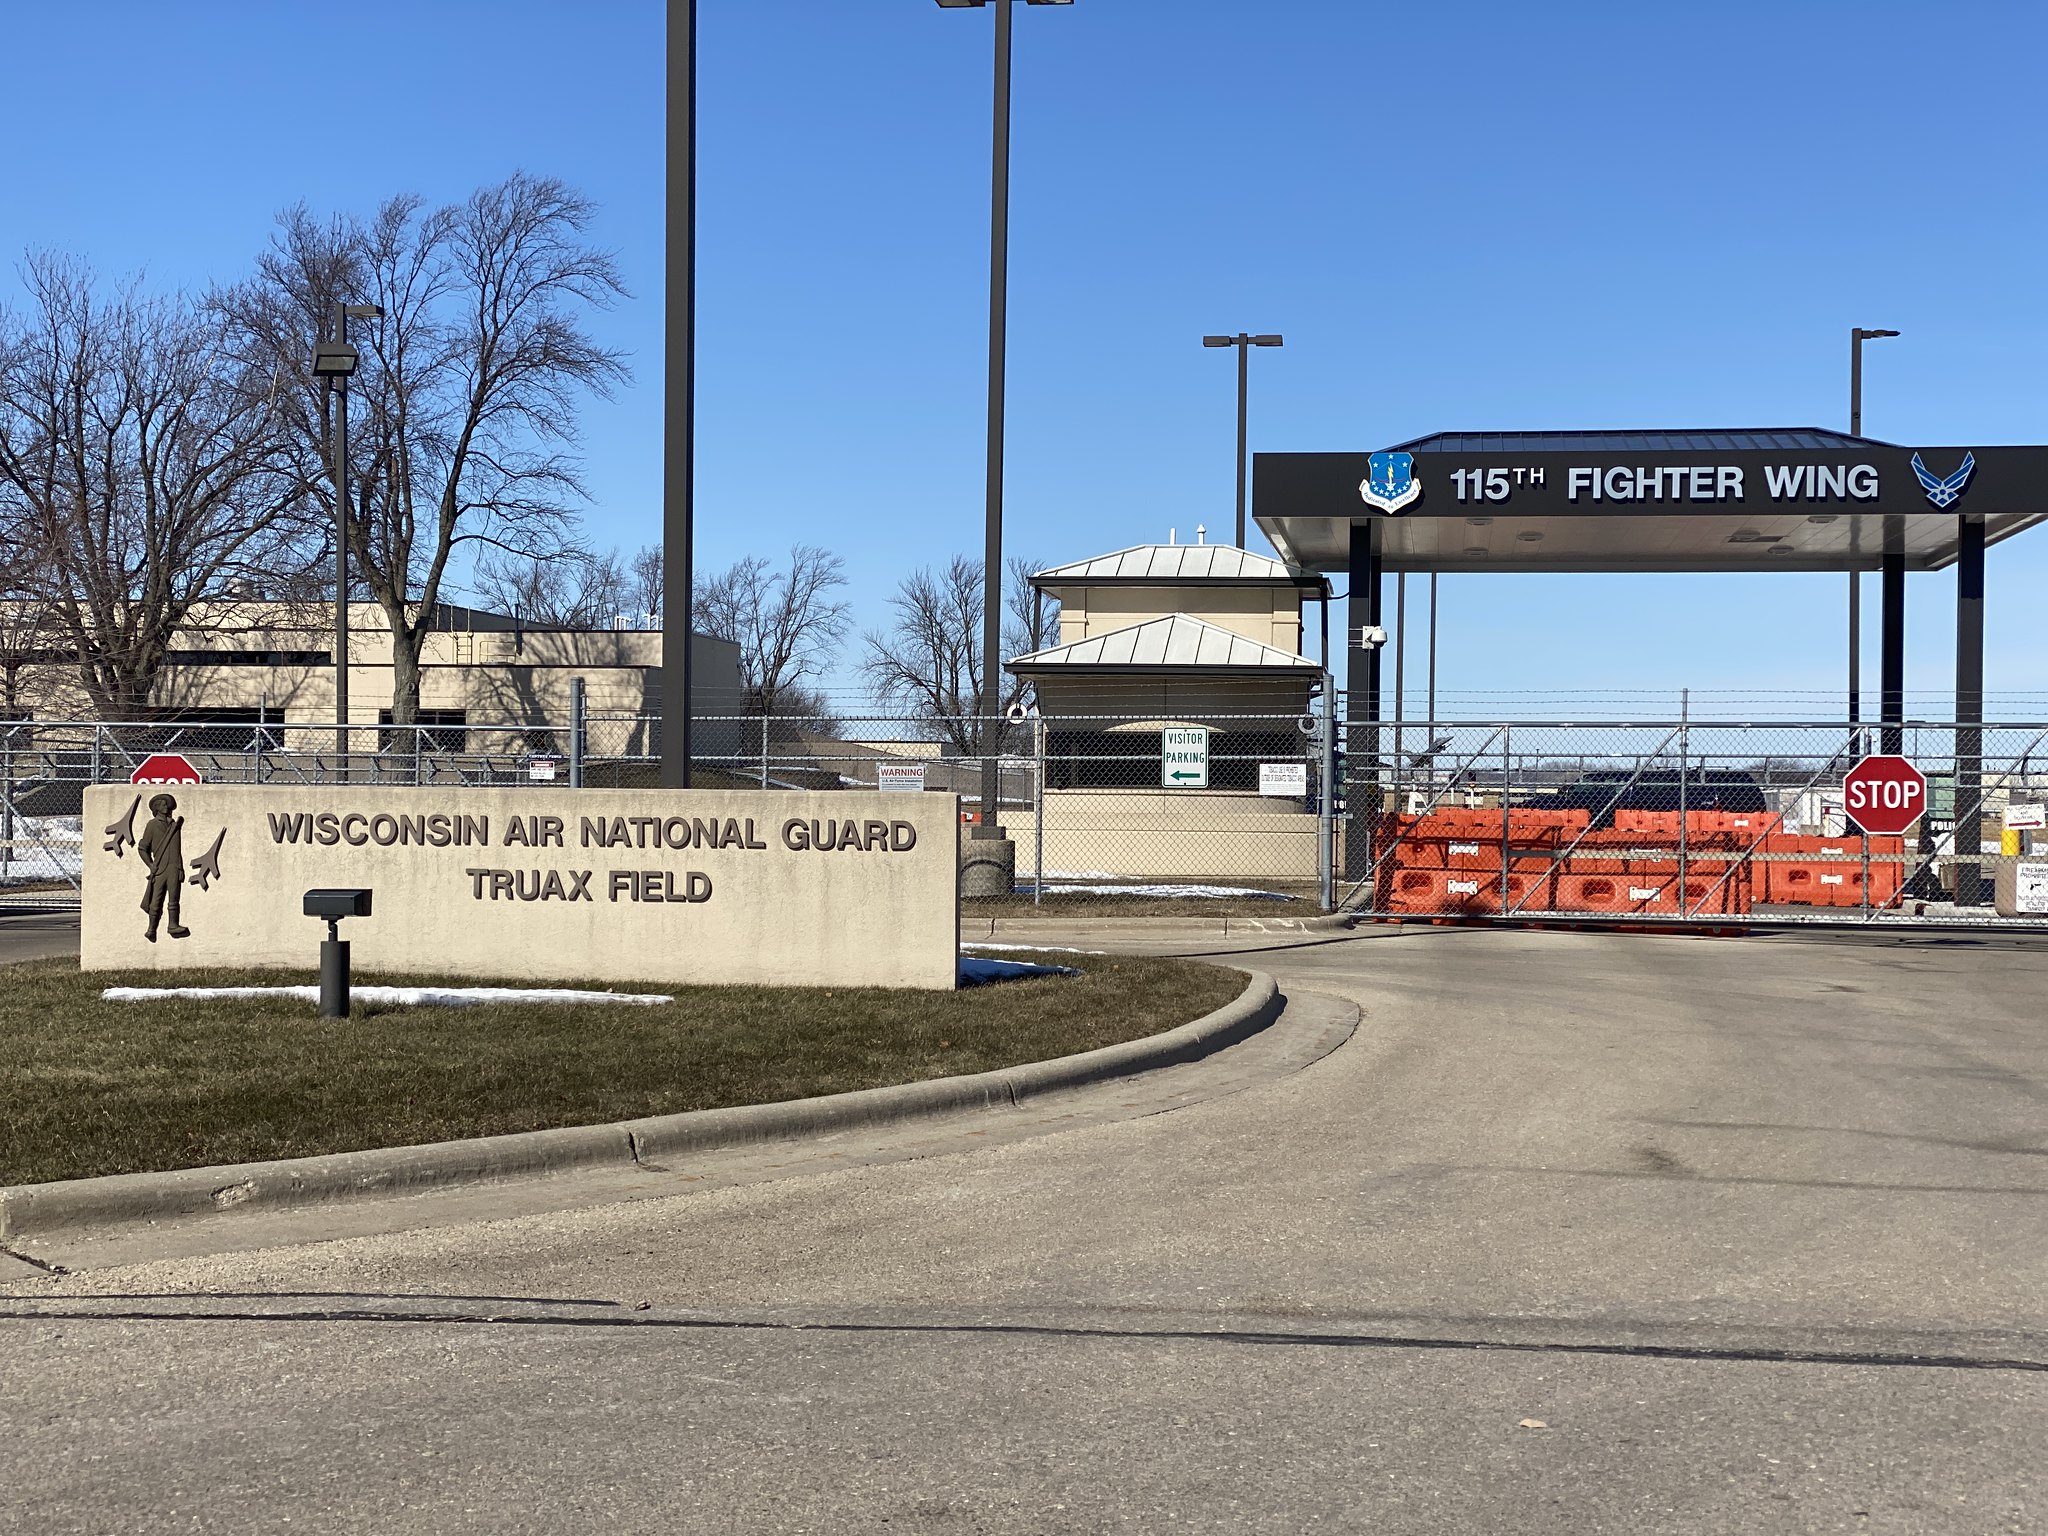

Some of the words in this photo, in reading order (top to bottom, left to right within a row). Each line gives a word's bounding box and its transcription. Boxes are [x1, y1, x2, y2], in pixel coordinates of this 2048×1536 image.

[1568, 466, 1744, 499] FIGHTER
[1764, 465, 1879, 499] WING
[1168, 733, 1203, 744] VISITOR
[1166, 752, 1204, 763] PARKING
[1849, 780, 1921, 809] STOP
[267, 812, 489, 847] WISCONSIN
[502, 815, 564, 848] AIR
[580, 816, 767, 850] NATIONAL
[781, 818, 917, 852] GUARD
[1930, 821, 1956, 831] POLI
[465, 867, 593, 902] TRUAX
[608, 870, 712, 903] FIELD
